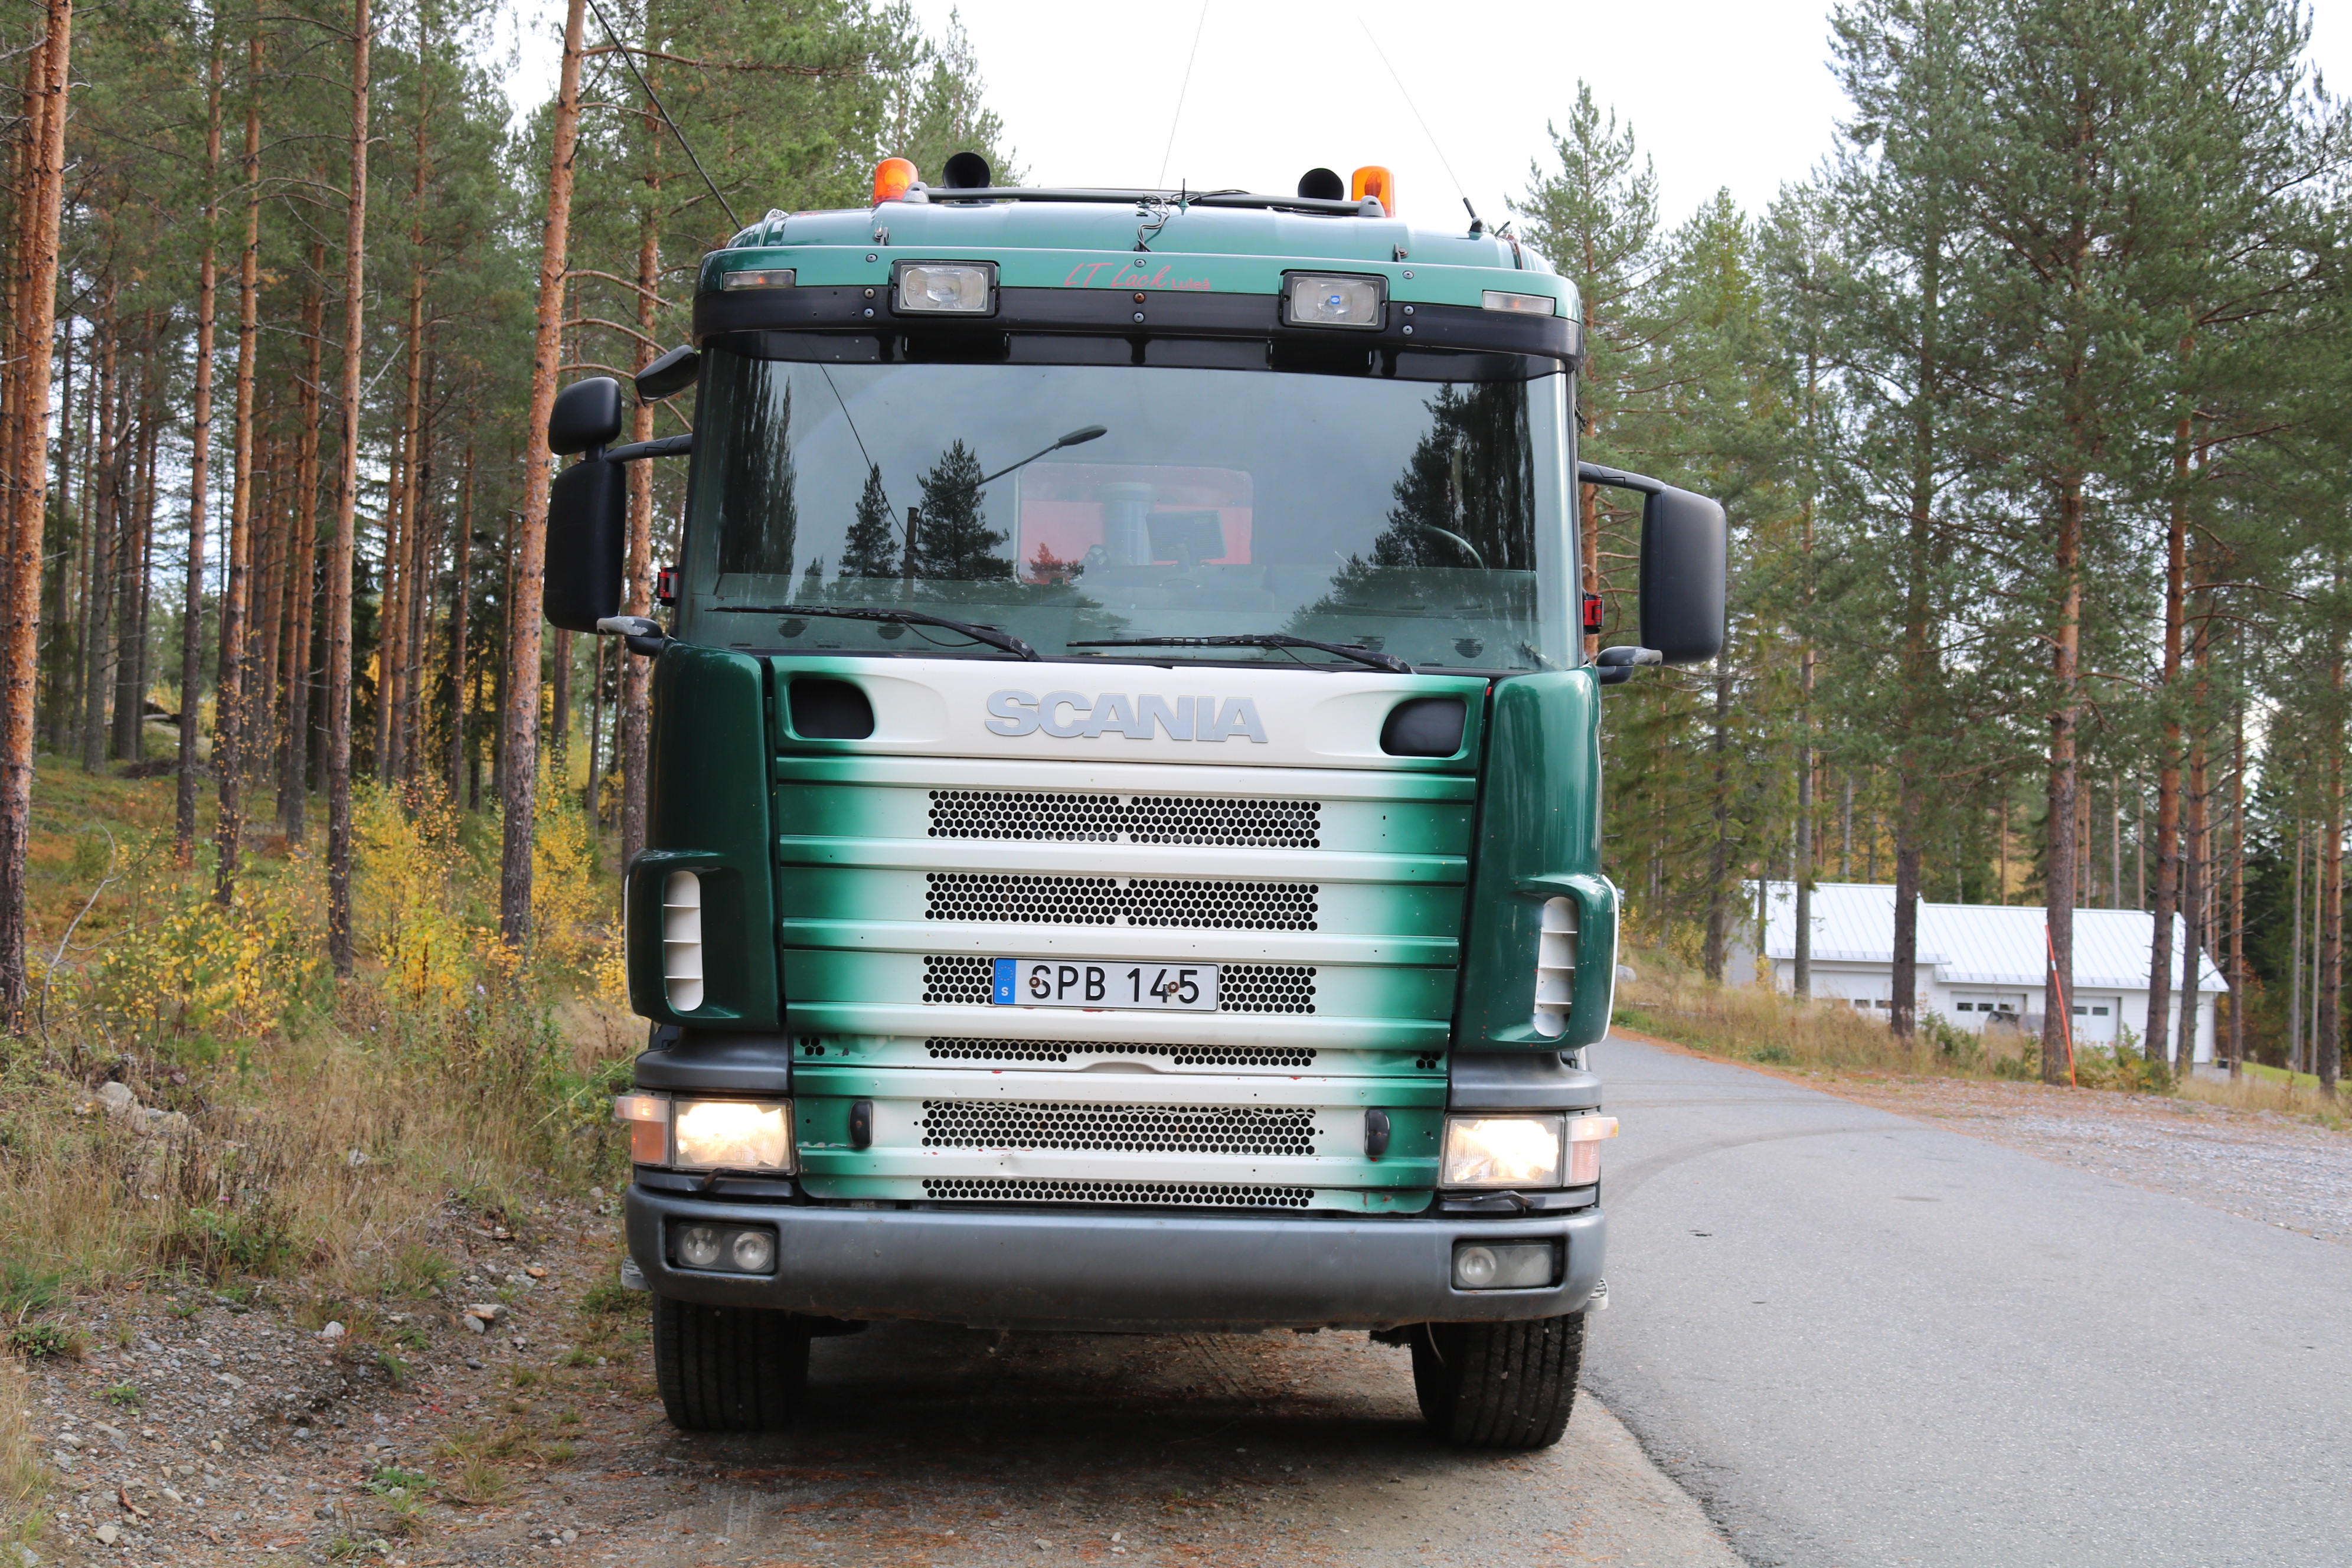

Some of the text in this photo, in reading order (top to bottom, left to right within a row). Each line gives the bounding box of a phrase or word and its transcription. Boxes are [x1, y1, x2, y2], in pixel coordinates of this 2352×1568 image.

[1064, 263, 1211, 290] LT Lack Luleå
[984, 689, 1269, 743] SCANIA
[1001, 986, 1009, 997] S
[1030, 965, 1200, 1004] SPB 145
